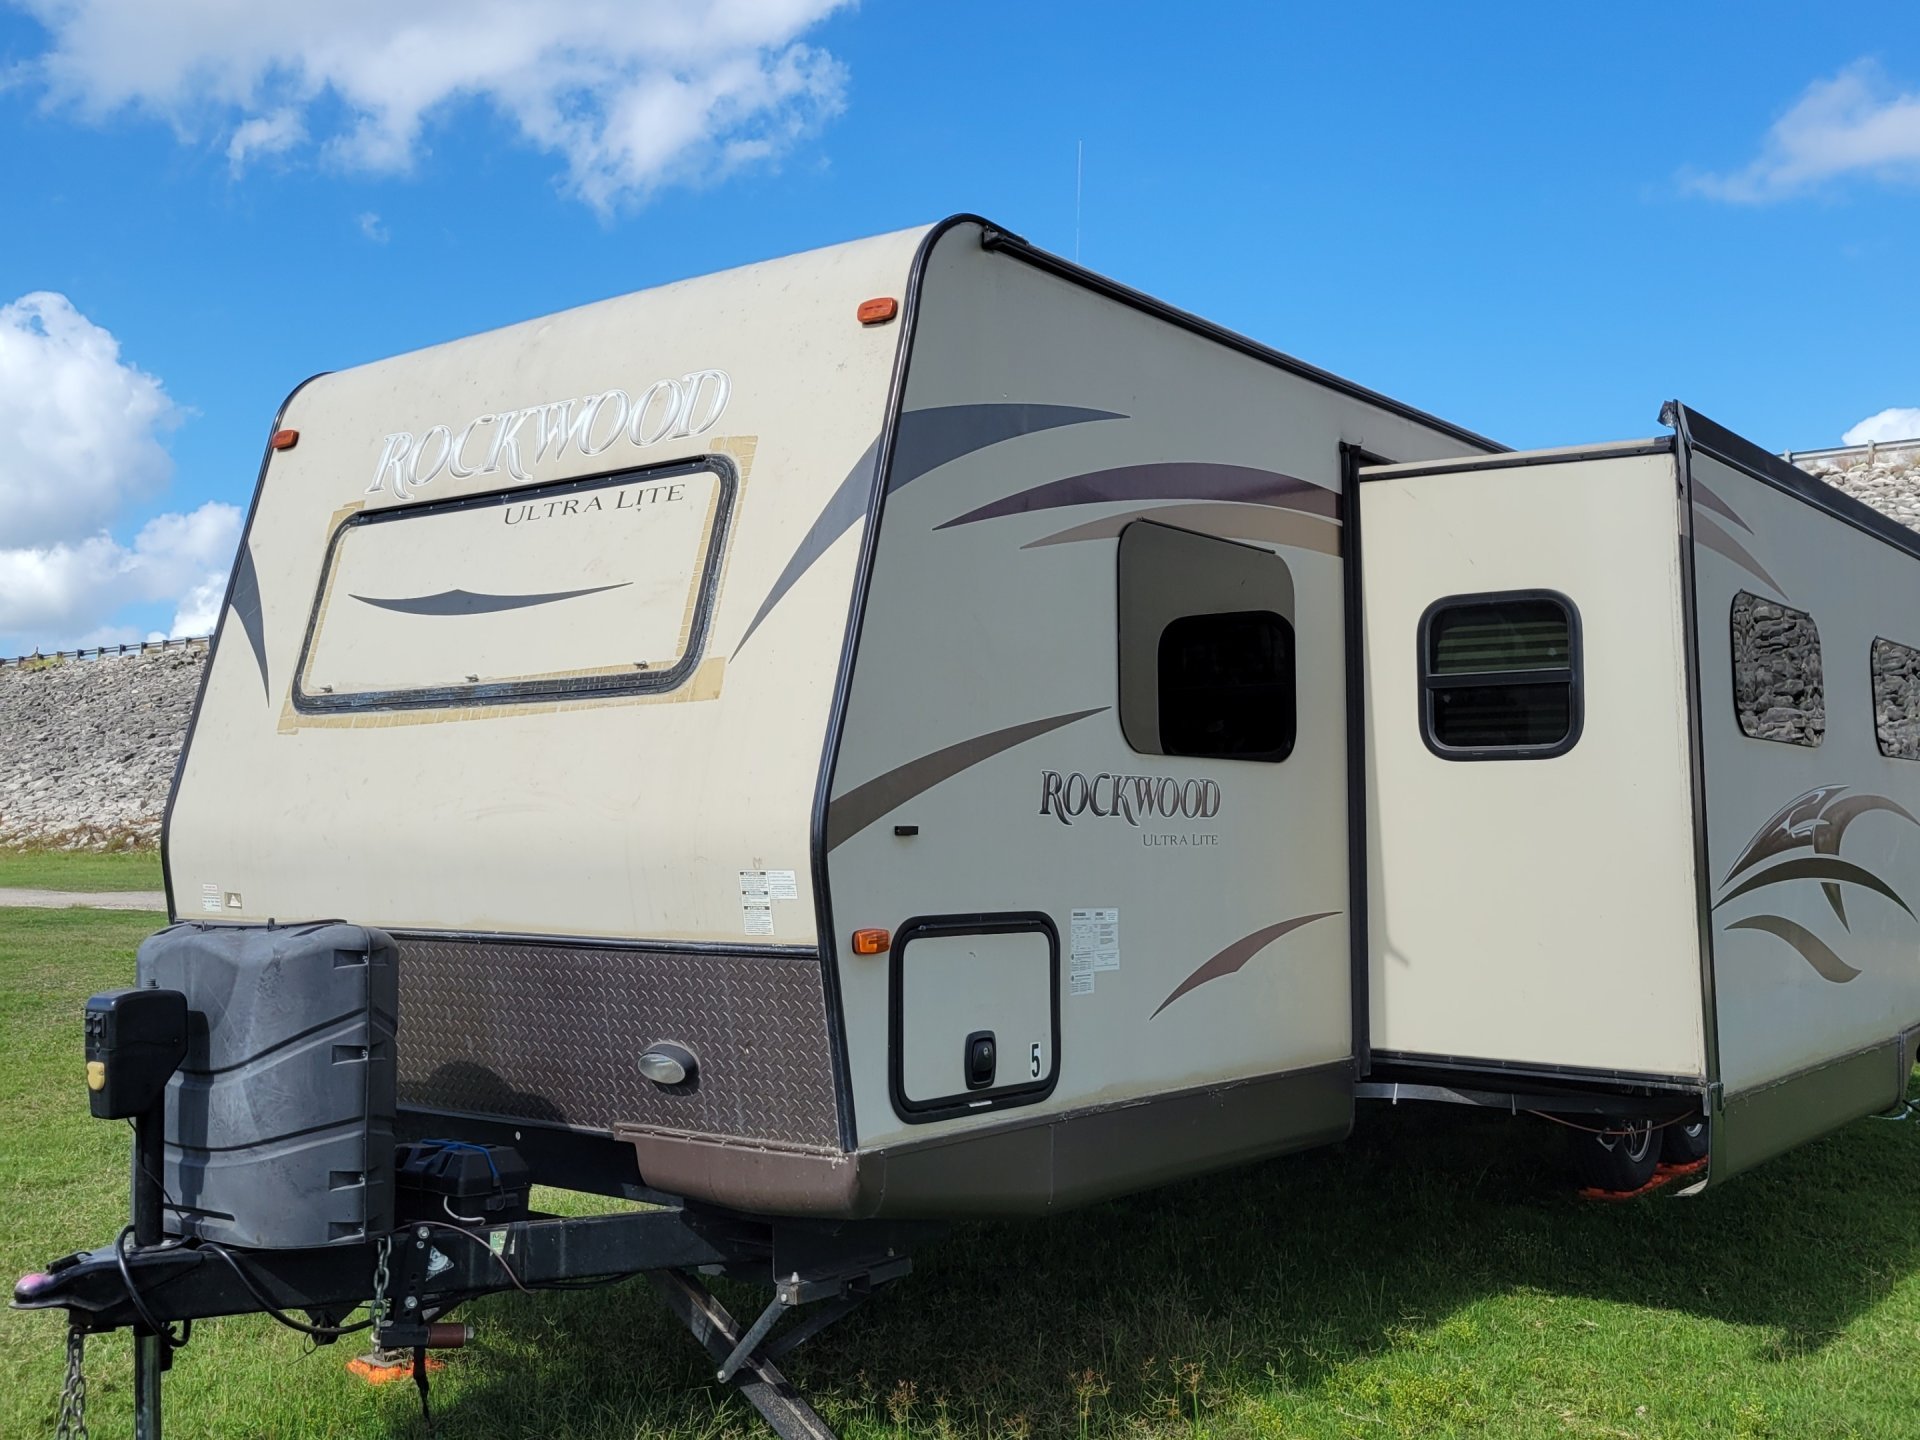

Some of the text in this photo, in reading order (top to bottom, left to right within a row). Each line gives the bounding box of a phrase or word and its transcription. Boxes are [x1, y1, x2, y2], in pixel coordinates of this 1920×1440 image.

[365, 368, 733, 500] ROCKWOOD
[504, 484, 686, 526] ULTRA LITE
[1039, 770, 1221, 826] ROCKWOOD
[1143, 833, 1219, 846] ULTRA LITE
[1031, 1043, 1040, 1078] 5
